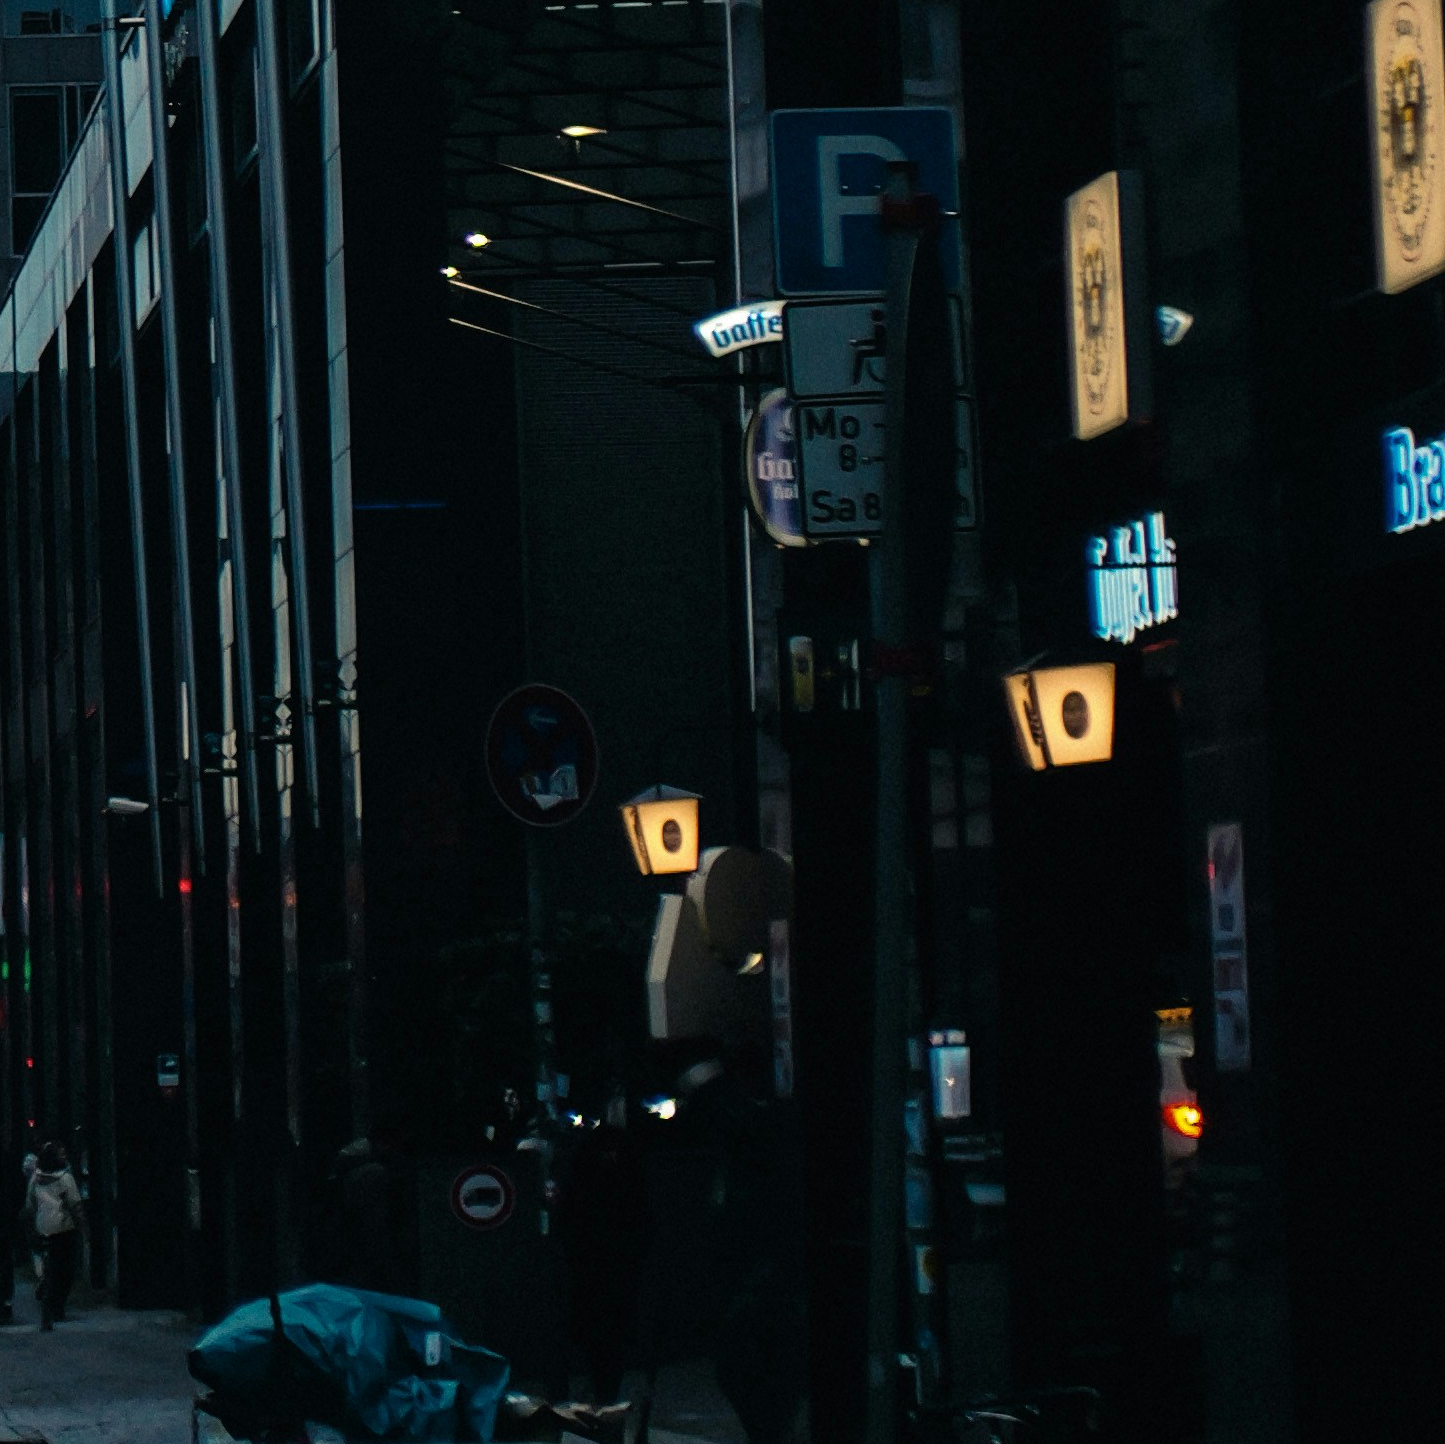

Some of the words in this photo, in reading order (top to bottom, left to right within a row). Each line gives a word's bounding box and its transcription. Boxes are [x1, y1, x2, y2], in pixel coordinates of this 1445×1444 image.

[817, 134, 909, 268] P
[804, 407, 861, 441] Mo
[810, 488, 857, 523] Sa
